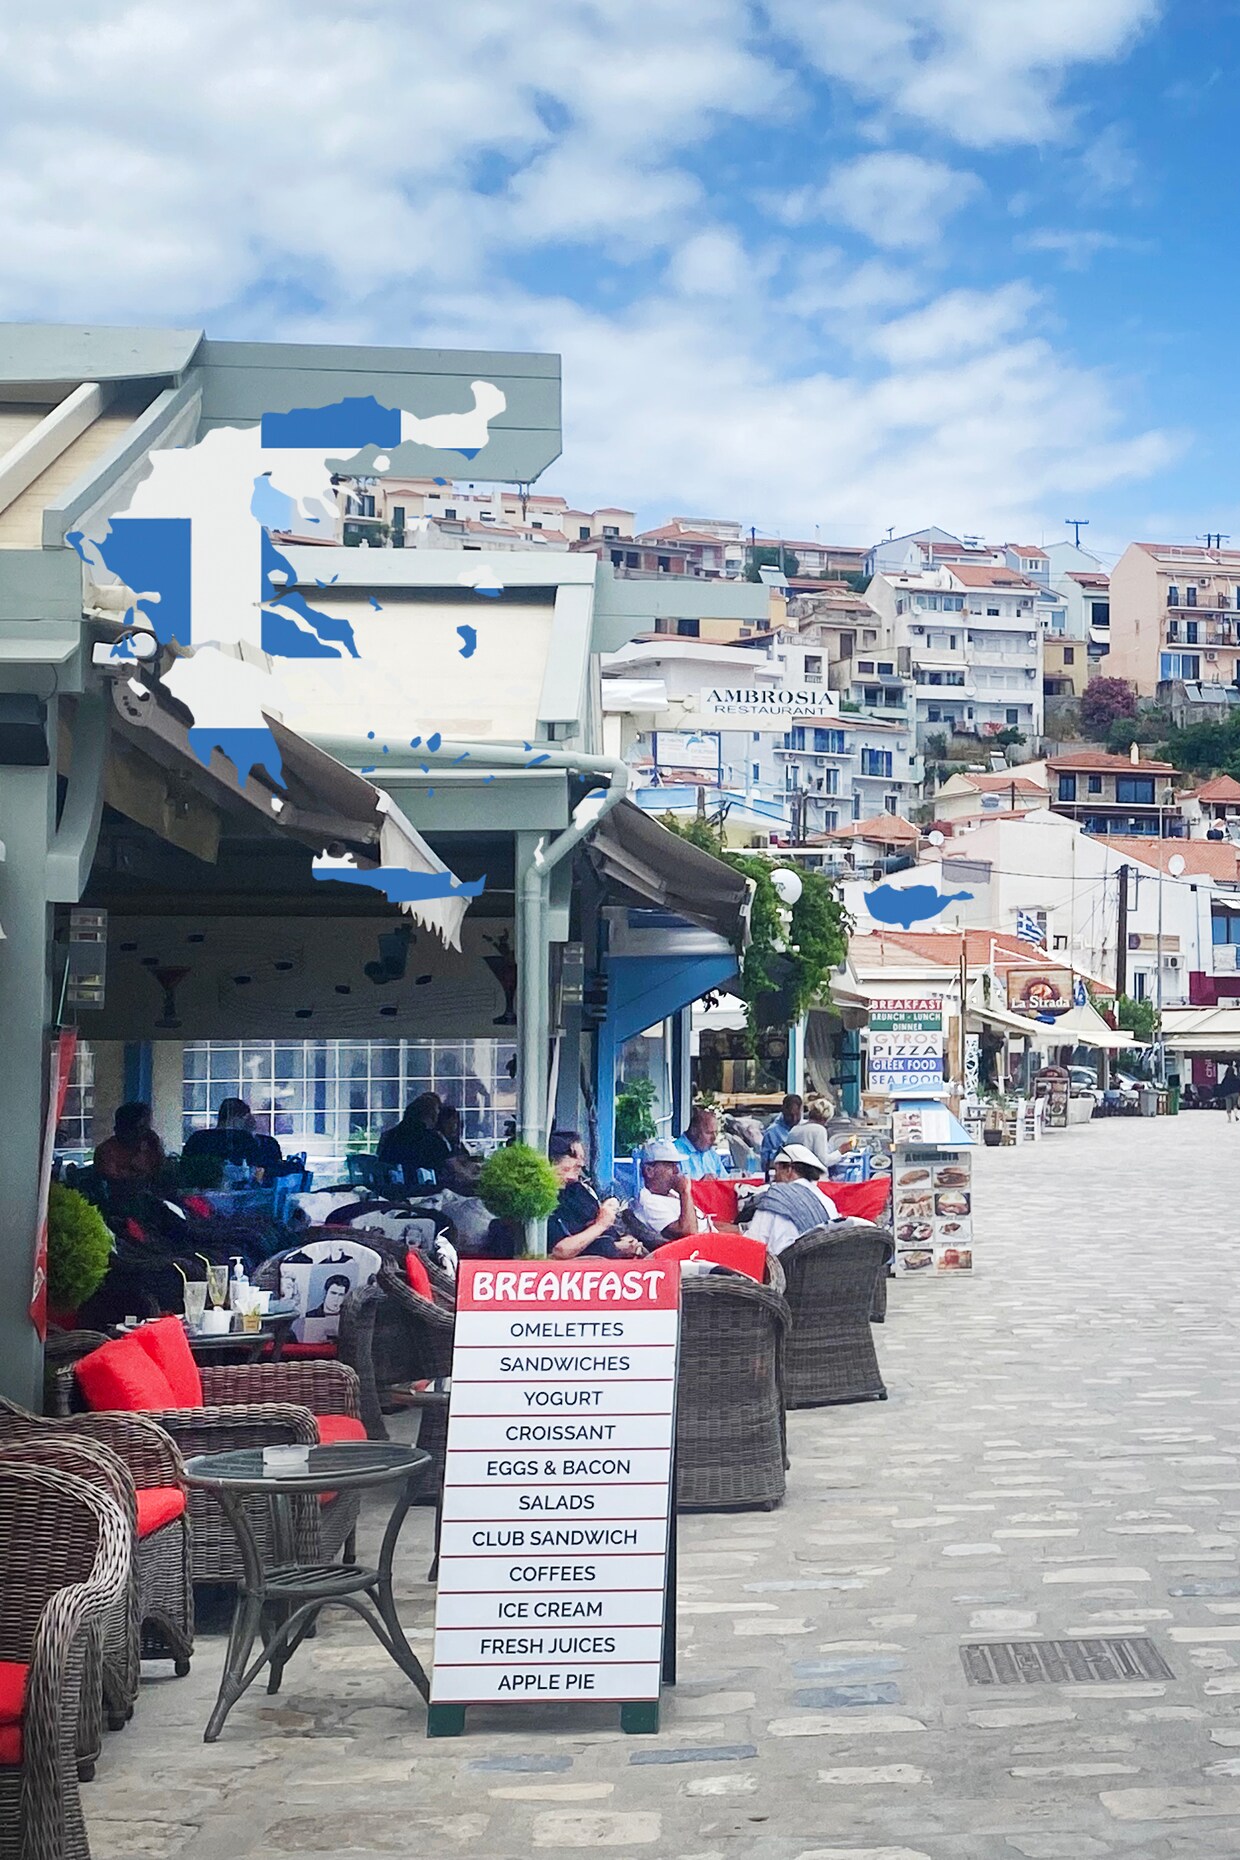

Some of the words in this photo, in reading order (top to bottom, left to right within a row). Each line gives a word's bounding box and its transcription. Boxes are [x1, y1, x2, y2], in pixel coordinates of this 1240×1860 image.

[707, 689, 834, 705] AMBROSIA
[714, 705, 826, 716] RESTAURANT
[871, 999, 942, 1010] BREAKFAST
[1011, 998, 1026, 1009] La
[1029, 996, 1070, 1009] Strada
[871, 1013, 905, 1021] BRUNCH
[913, 1013, 941, 1021] LUNCH
[892, 1022, 923, 1031] DINNER
[875, 1034, 938, 1044] GYROS
[873, 1046, 938, 1056] PIZZA
[873, 1060, 904, 1070] GREEK
[908, 1060, 936, 1070] FOOD
[872, 1075, 896, 1085] SEA
[902, 1075, 940, 1085] FOOD
[472, 1270, 665, 1302] BREAKFAST
[510, 1323, 624, 1337] OMELETTES
[500, 1356, 630, 1371] SANDWICHES
[524, 1390, 603, 1406] YOGURT
[506, 1425, 616, 1441] CROISSANT
[487, 1460, 537, 1476] EGGS
[544, 1461, 556, 1476] &
[563, 1459, 630, 1475] BACON
[519, 1495, 595, 1510] SALADS
[472, 1531, 524, 1546] CLUB
[530, 1529, 637, 1546] SANDWICH
[509, 1566, 595, 1582] COFFEES
[498, 1602, 528, 1618] ICE
[534, 1601, 602, 1617] CREAM
[480, 1638, 543, 1655] FRESH
[548, 1637, 615, 1654] JUICES
[498, 1674, 560, 1691] APPLE
[566, 1674, 595, 1689] PIE
